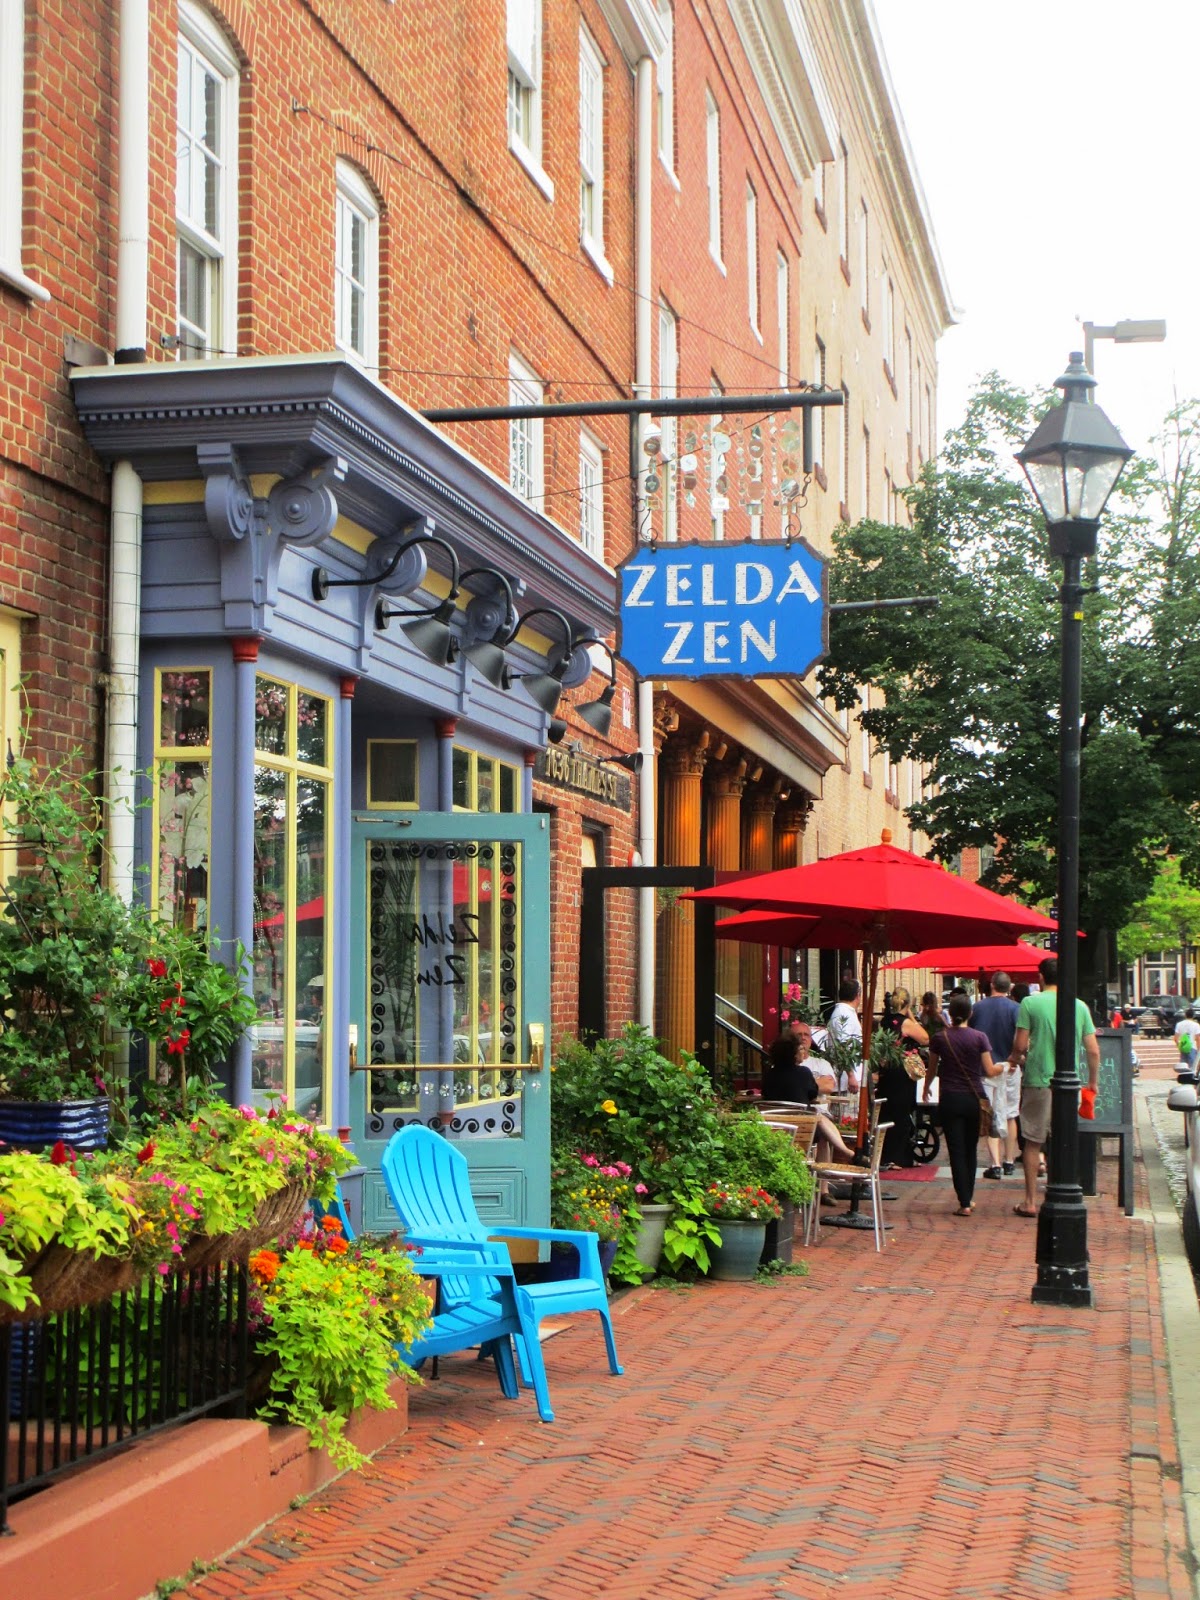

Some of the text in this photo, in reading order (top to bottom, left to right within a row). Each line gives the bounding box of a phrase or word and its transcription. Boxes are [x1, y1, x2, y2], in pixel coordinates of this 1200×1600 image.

[624, 560, 820, 606] ZELDA
[661, 619, 777, 664] ZEN
[545, 747, 618, 801] 1636 THAMES ST
